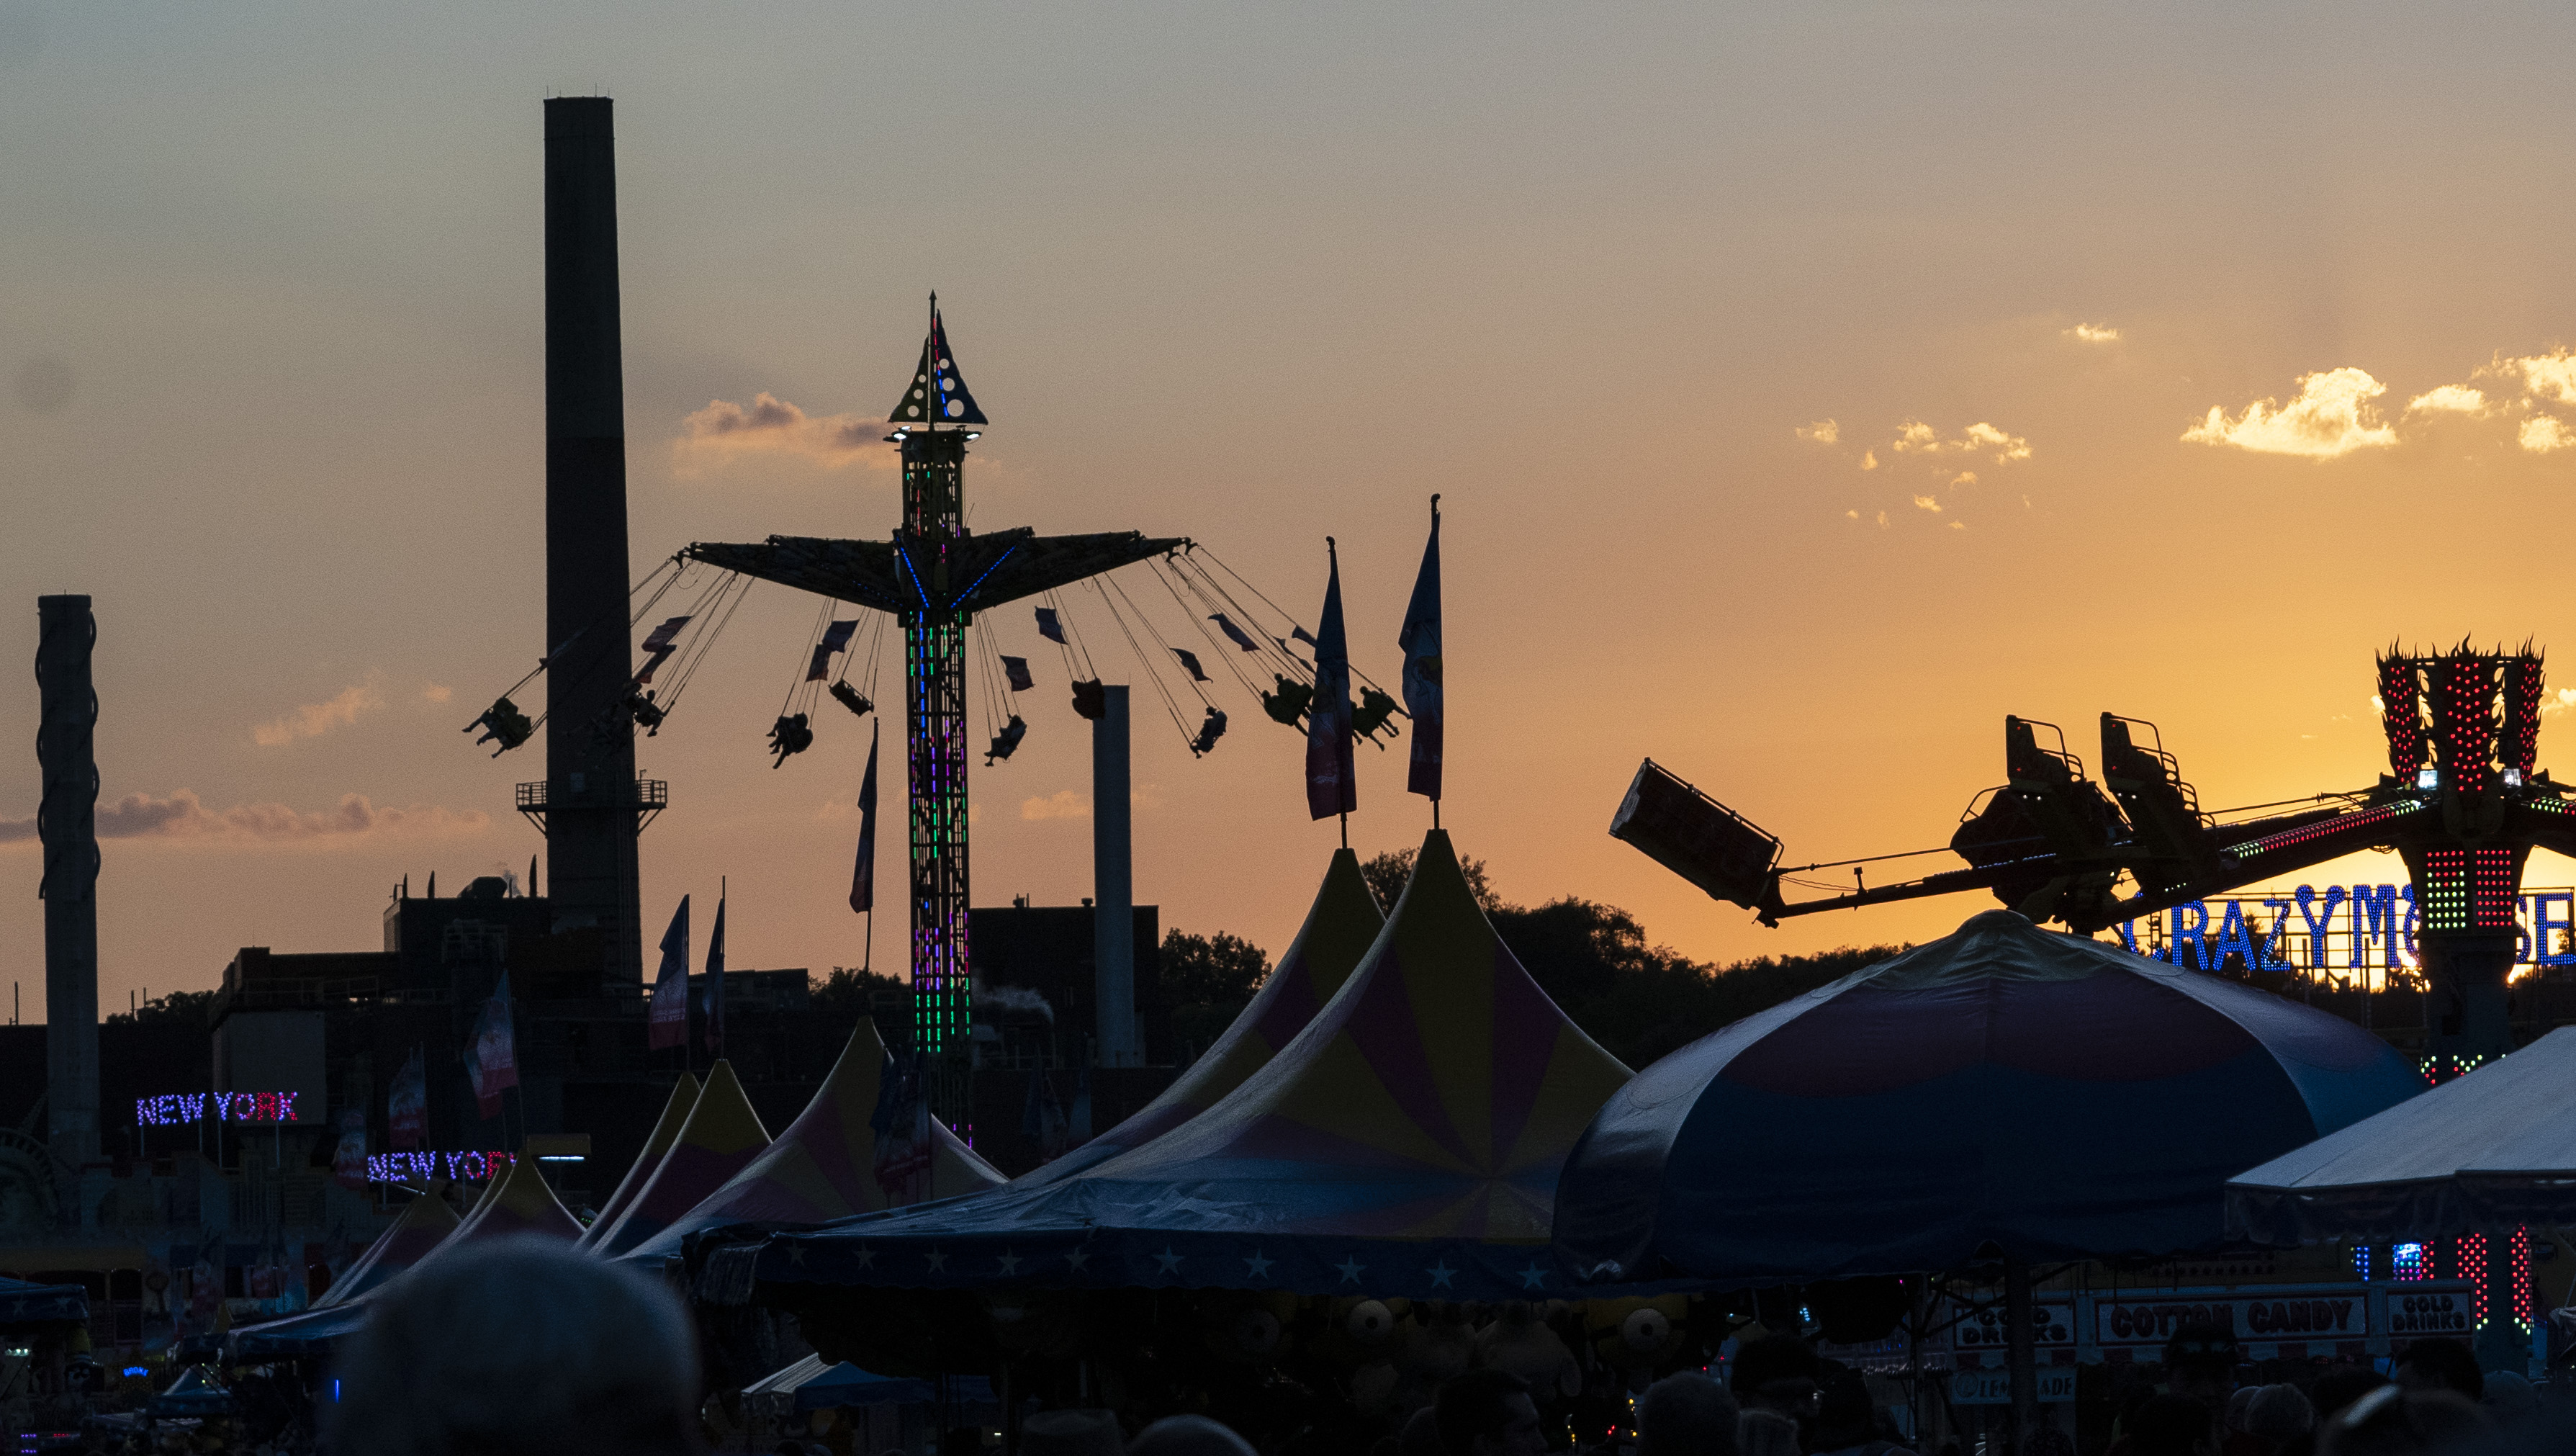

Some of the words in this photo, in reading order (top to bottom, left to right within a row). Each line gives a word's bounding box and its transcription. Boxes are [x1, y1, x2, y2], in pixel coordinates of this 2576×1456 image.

[137, 1092, 206, 1126] NEW
[214, 1091, 298, 1121] YORK
[367, 1151, 436, 1181] NEW
[446, 1151, 517, 1179] YOR
[2402, 1295, 2454, 1313] COLD
[1978, 1307, 2051, 1326] COD
[2111, 1304, 2233, 1339] COTTON
[2248, 1300, 2351, 1334] CANDY
[2392, 1312, 2466, 1331] DRINKS
[1963, 1324, 2068, 1344] DRIKS
[1979, 1377, 2073, 1398] LEMADE
